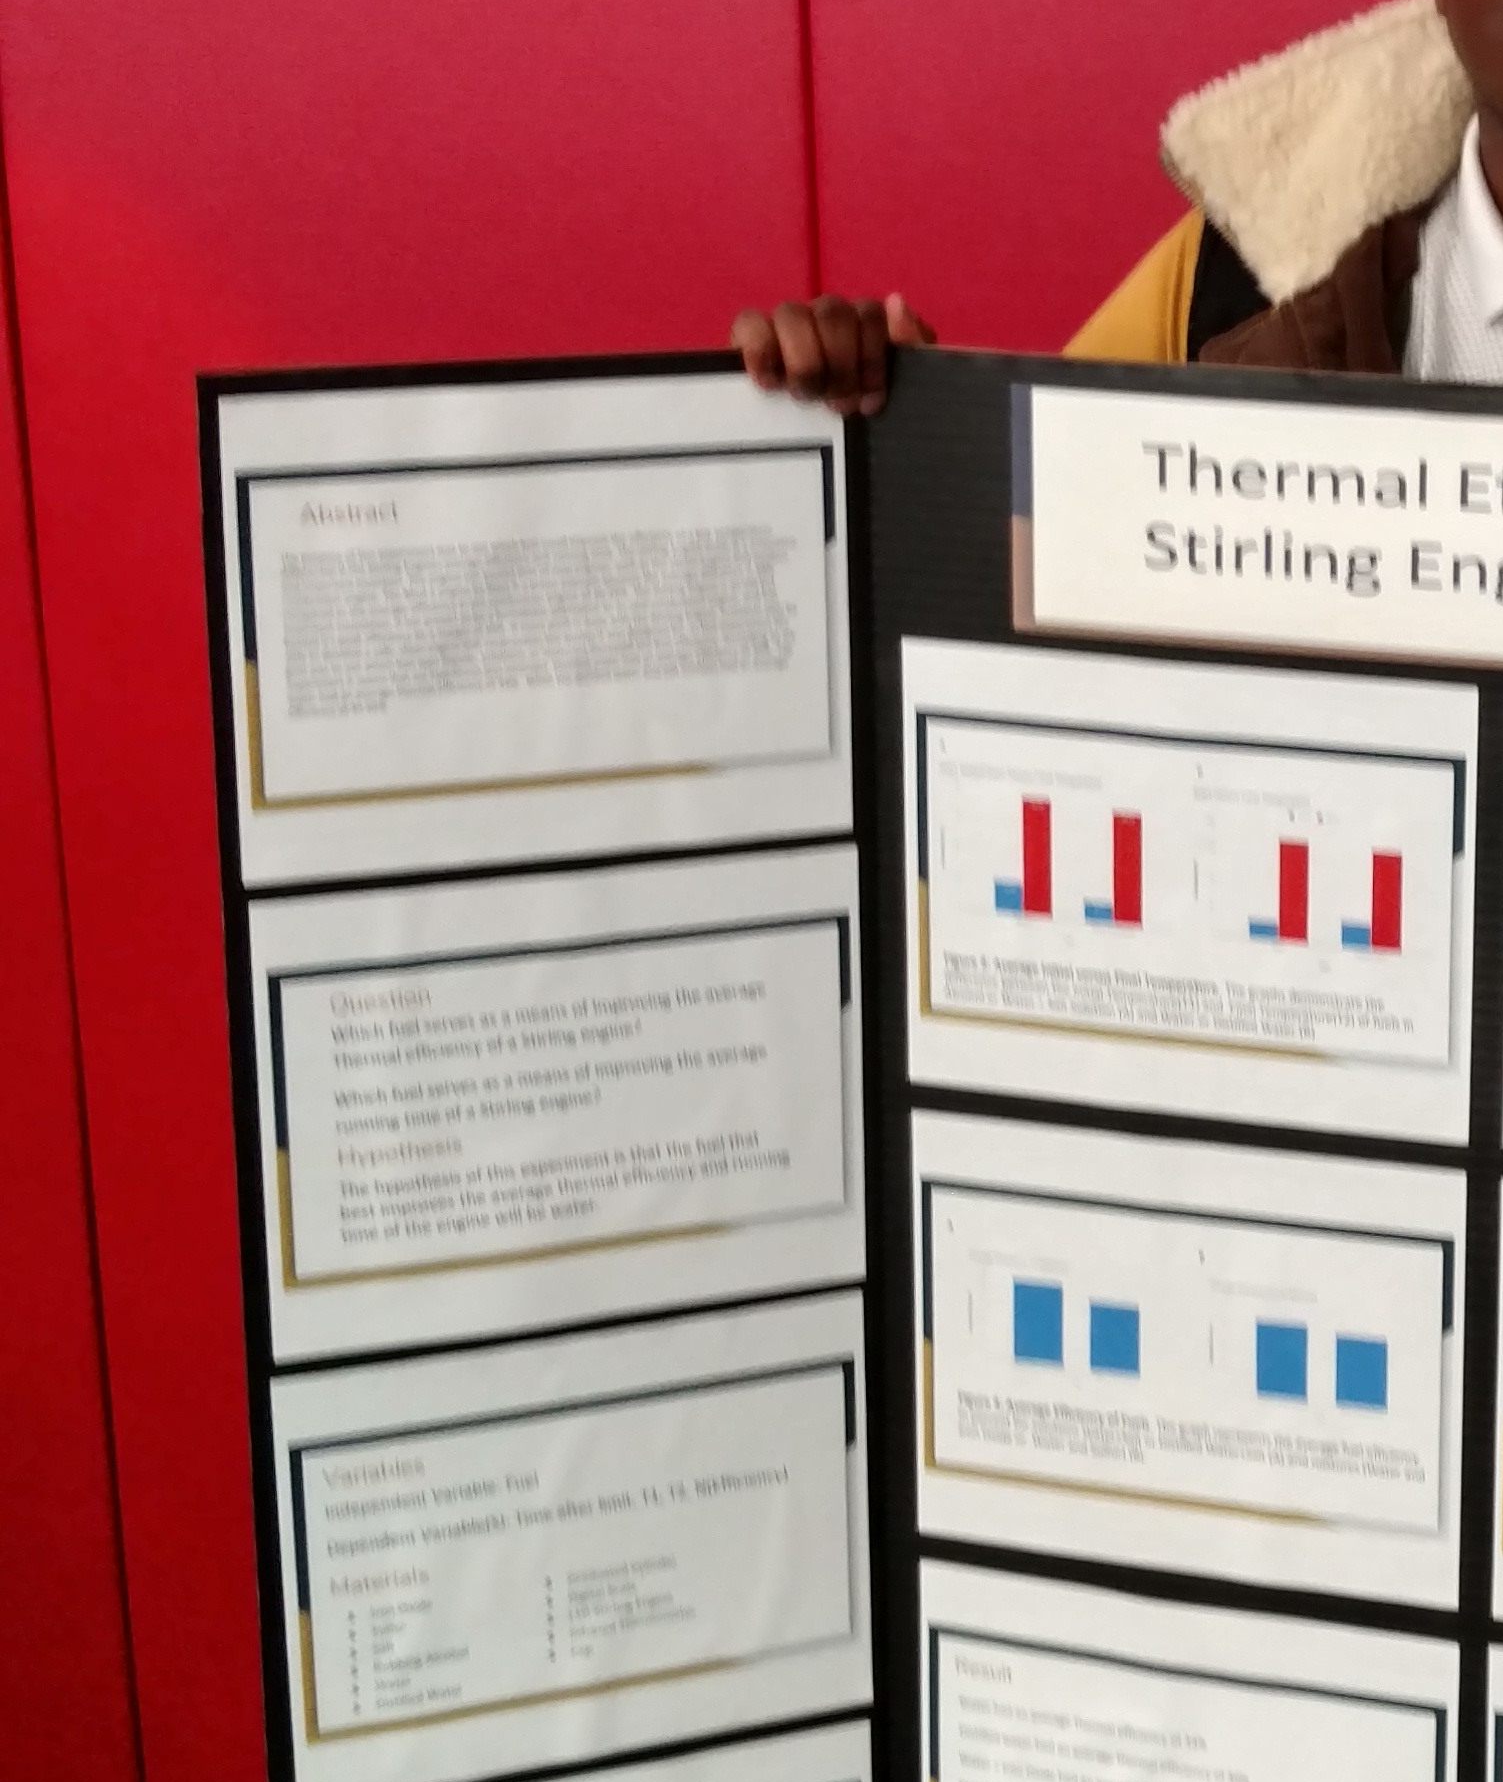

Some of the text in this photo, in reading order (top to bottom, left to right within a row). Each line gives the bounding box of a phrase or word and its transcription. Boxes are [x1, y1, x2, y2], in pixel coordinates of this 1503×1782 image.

[1141, 440, 1429, 510] Thermal
[1141, 521, 1383, 597] Stirling
[329, 986, 431, 1018] Question
[337, 1135, 462, 1169] Hypothesis
[329, 1565, 430, 1596] Materials
